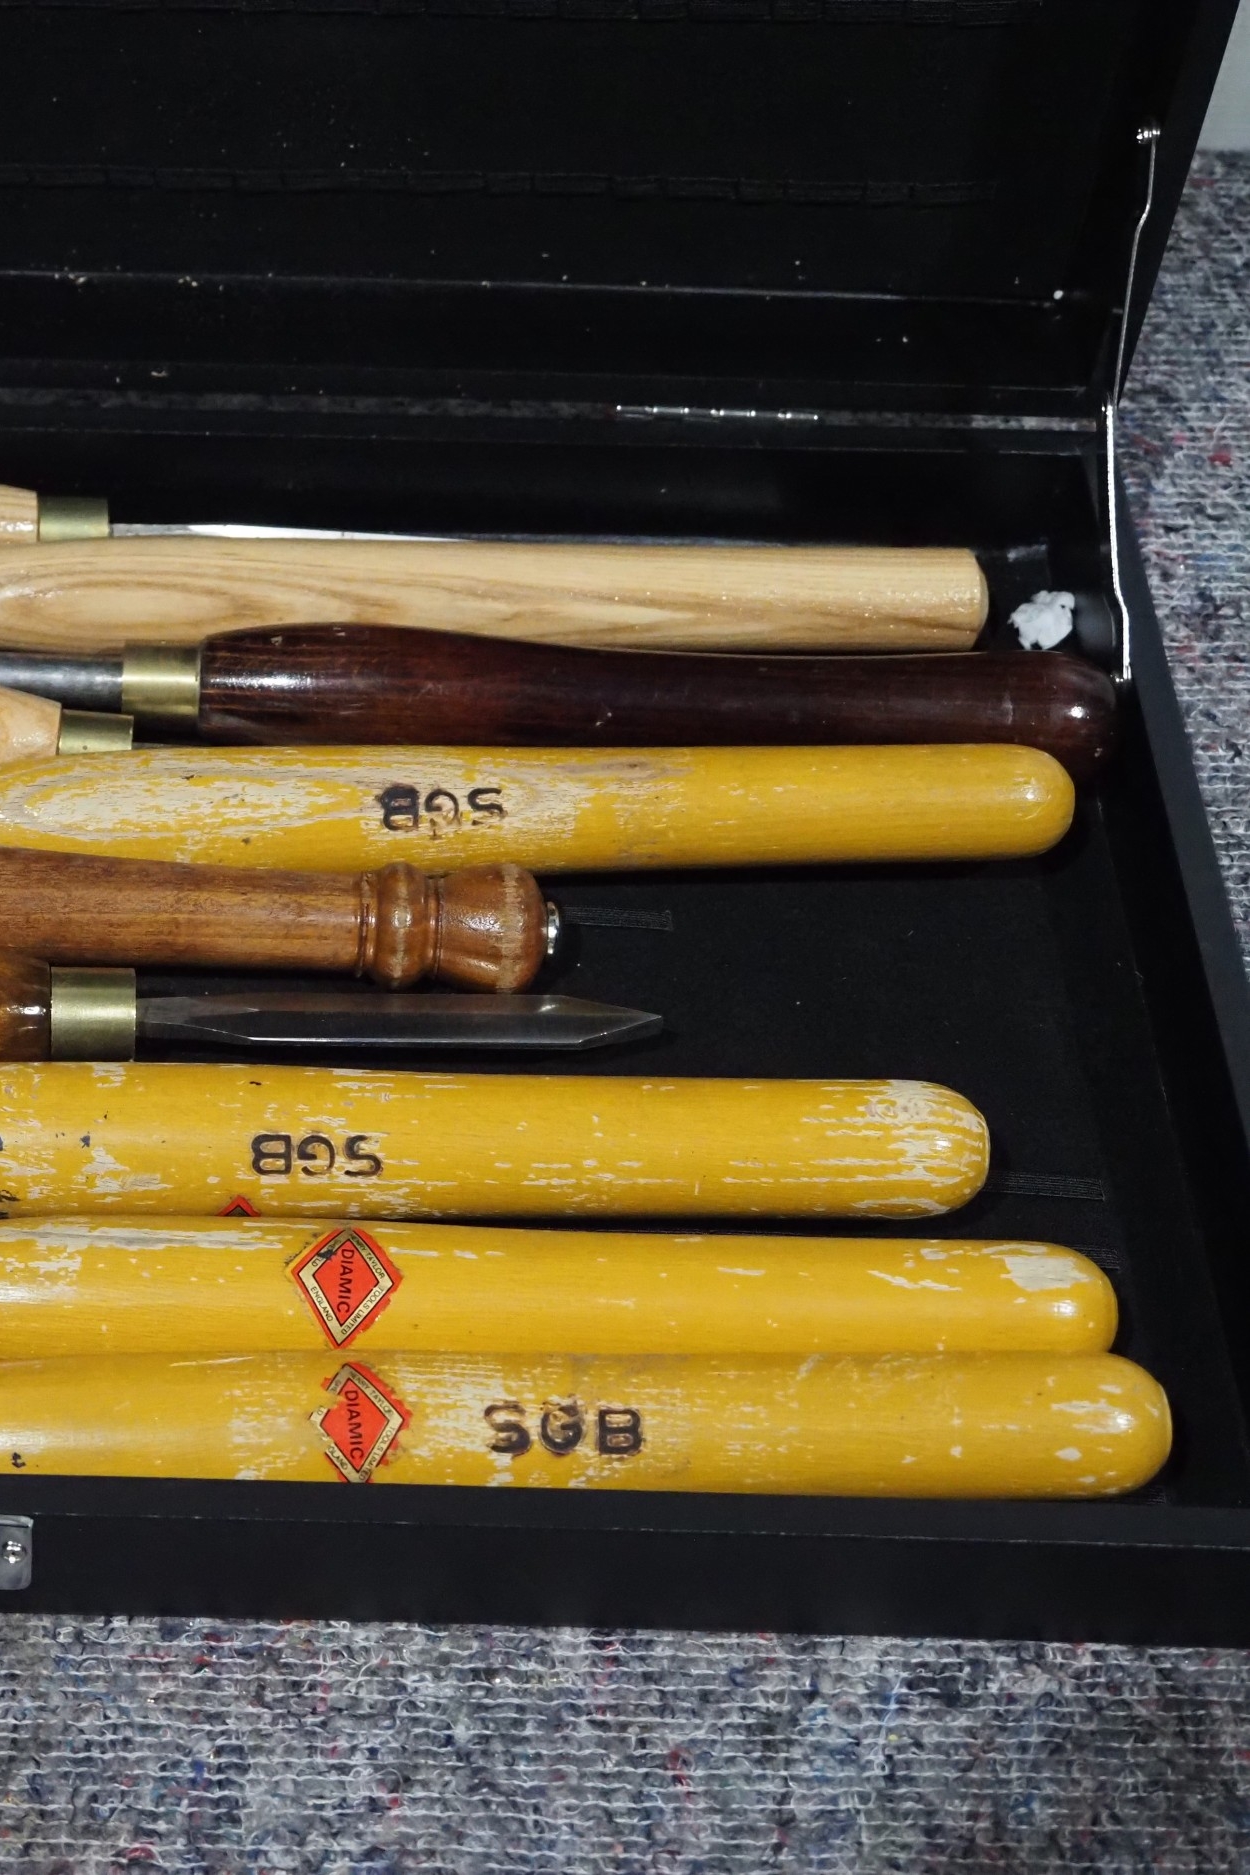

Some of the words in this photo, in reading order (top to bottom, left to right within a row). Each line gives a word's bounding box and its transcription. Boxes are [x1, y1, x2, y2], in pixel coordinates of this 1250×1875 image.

[380, 784, 507, 832] SGB
[251, 1134, 384, 1177] SGB
[336, 1248, 355, 1314] DIAMIC
[365, 1252, 386, 1280] TAYLOR
[310, 1286, 334, 1322] ENGLAND
[362, 1286, 384, 1310] TOOLS
[341, 1309, 365, 1336] LIMITED
[344, 1390, 364, 1460] DIAMIC
[377, 1426, 397, 1453] TOOLS
[484, 1399, 643, 1456] SGB
